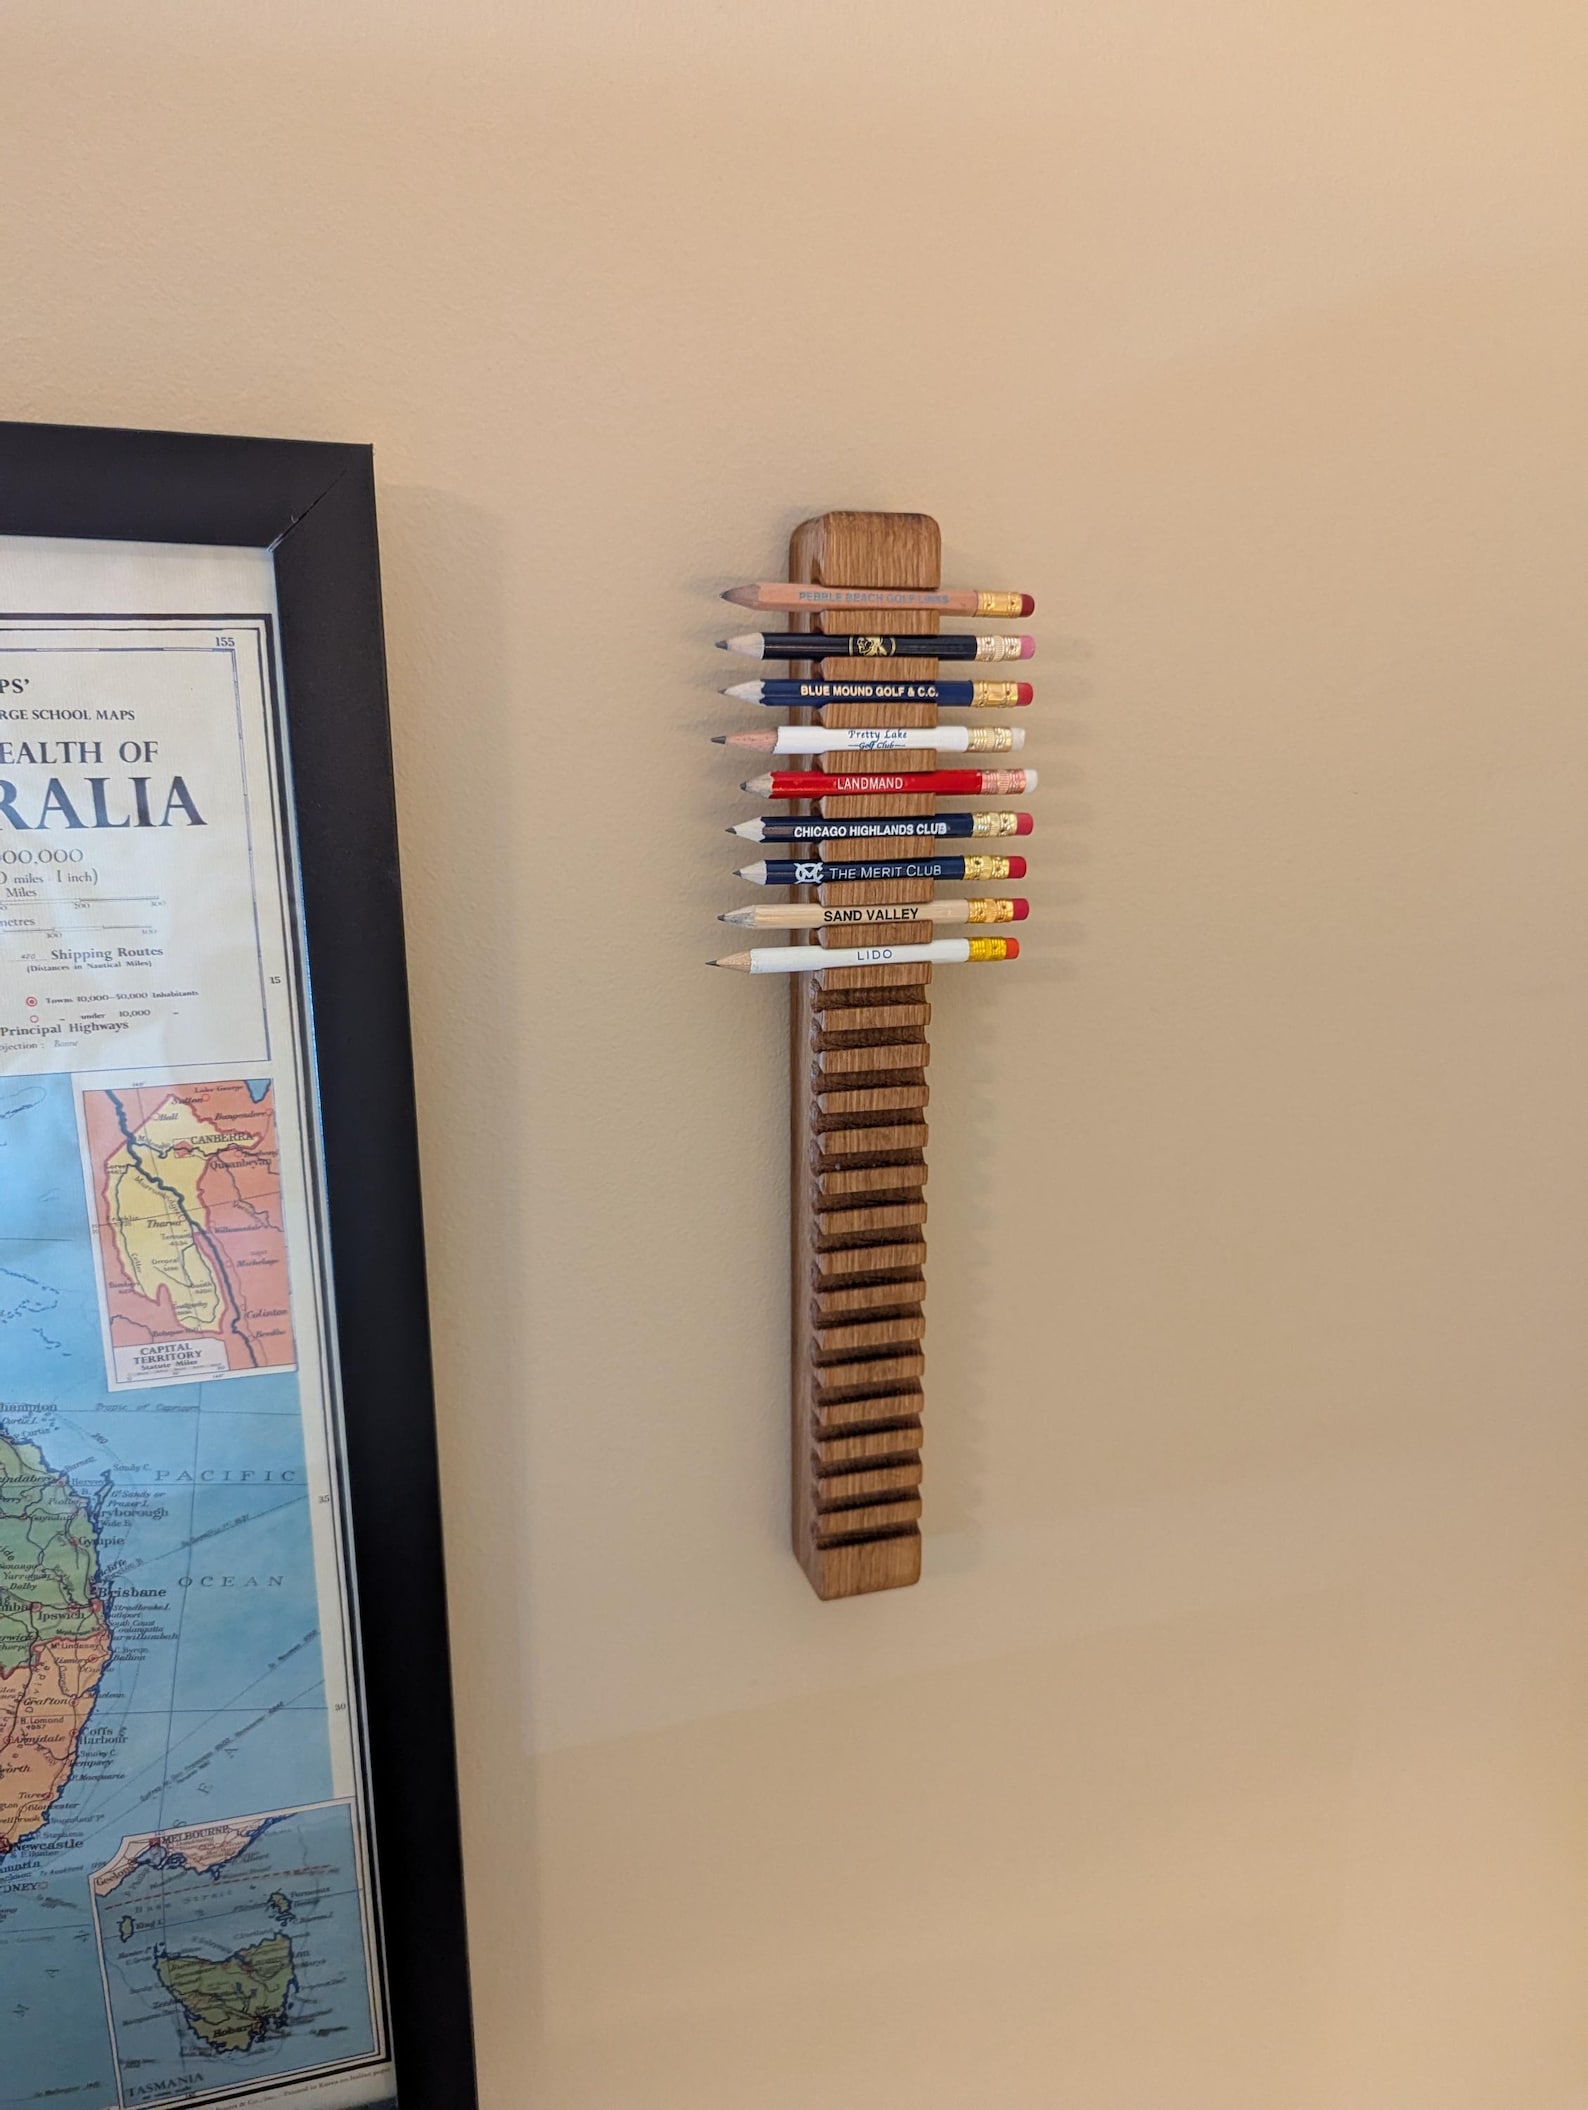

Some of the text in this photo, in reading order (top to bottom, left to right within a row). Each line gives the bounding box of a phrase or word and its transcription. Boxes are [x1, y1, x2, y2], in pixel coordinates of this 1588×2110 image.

[799, 591, 949, 604] PEBBLE BEACH GOLF LINKS
[216, 637, 235, 647] 155
[800, 684, 939, 697] BLUE MOUND GOLF & C.C.
[32, 709, 91, 721] SCHOOL
[96, 709, 135, 721] MAPS
[848, 728, 907, 741] Pretty Lake
[859, 740, 894, 750] Golf Club
[119, 741, 158, 763] OF
[837, 777, 903, 790] LANDMAND
[794, 822, 947, 838] CHICAGO HIGHLANDS CLUB
[14, 872, 44, 884] miles
[67, 869, 98, 886] inch)
[830, 864, 942, 880] THE MERIT CLUB
[6, 888, 37, 898] Miles
[824, 908, 919, 922] SAND VALLEY
[51, 949, 113, 962] Shipping
[118, 948, 163, 958] Routes
[857, 949, 893, 961] LIDO
[270, 976, 281, 984] 15
[0, 1021, 129, 1037] Principal Highways
[191, 1132, 255, 1144] CANBERRA
[140, 1342, 193, 1356] CAPITAL
[133, 1350, 202, 1365] TERRITORY
[155, 1470, 296, 1481] PACIFIC
[178, 1576, 284, 1587] OCEAN
[98, 1587, 167, 1598] Brisbane
[129, 2072, 204, 2097] TASMANIA
